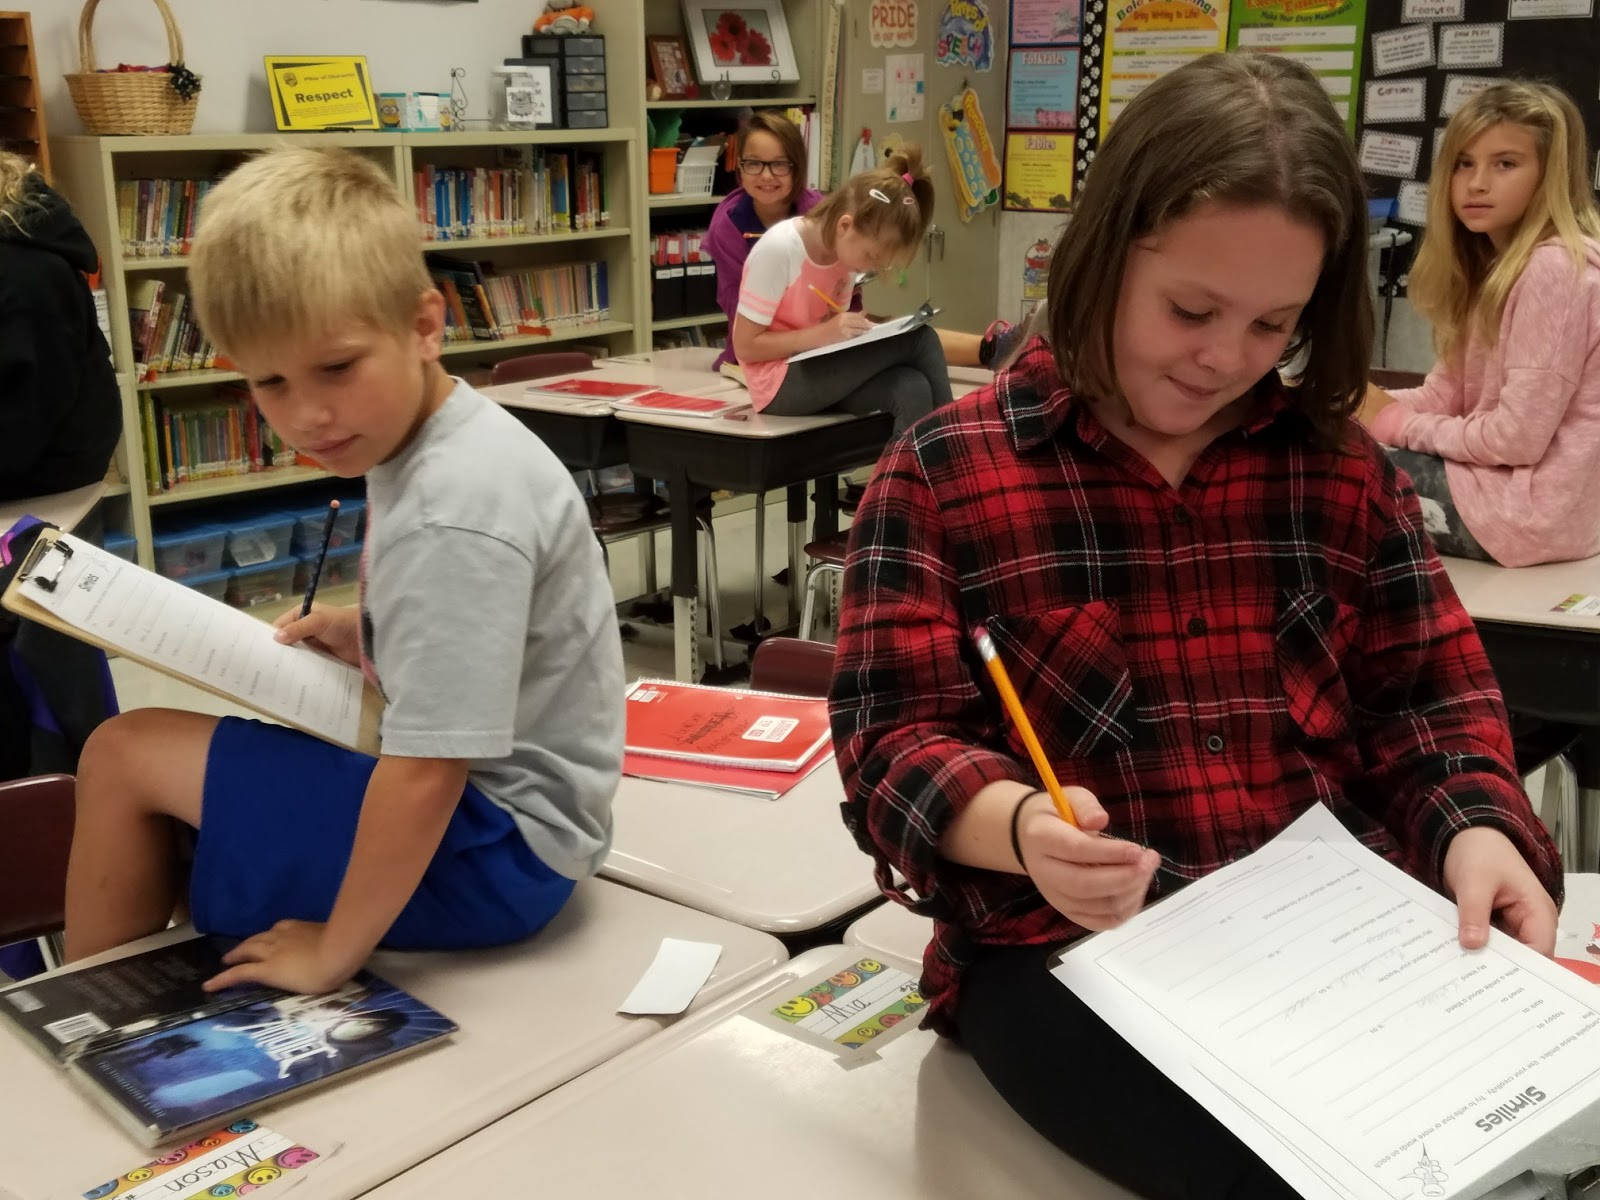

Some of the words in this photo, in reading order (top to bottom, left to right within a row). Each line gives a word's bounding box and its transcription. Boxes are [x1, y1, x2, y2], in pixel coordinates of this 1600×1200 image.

[872, 4, 915, 28] PRIDE
[1152, 10, 1174, 22] Writing
[1176, 9, 1183, 18] to
[1411, 6, 1455, 16] Features
[1021, 51, 1067, 66] Folktales
[295, 88, 354, 103] Respect
[1024, 135, 1056, 151] Fables
[1411, 952, 1429, 964] about
[1399, 961, 1412, 971] your
[1505, 967, 1520, 976] Write
[1460, 970, 1478, 981] friend
[1484, 978, 1500, 989] simile
[1467, 989, 1484, 1000] about
[1508, 987, 1524, 999] smart
[1530, 999, 1543, 1008] dark
[821, 997, 871, 1024] Mia
[1544, 1011, 1564, 1024] happy
[1560, 1035, 1577, 1047] these
[213, 1019, 337, 1078] AMULET
[1527, 1060, 1540, 1068] Use
[1514, 1067, 1527, 1077] your
[1453, 1106, 1469, 1116] write
[1476, 1087, 1545, 1131] Similes
[1441, 1115, 1455, 1124] four
[1418, 1127, 1434, 1139] more
[1399, 1138, 1418, 1151] words
[1390, 1149, 1400, 1157] on
[1373, 1155, 1391, 1168] each
[163, 1145, 262, 1192] Mason
